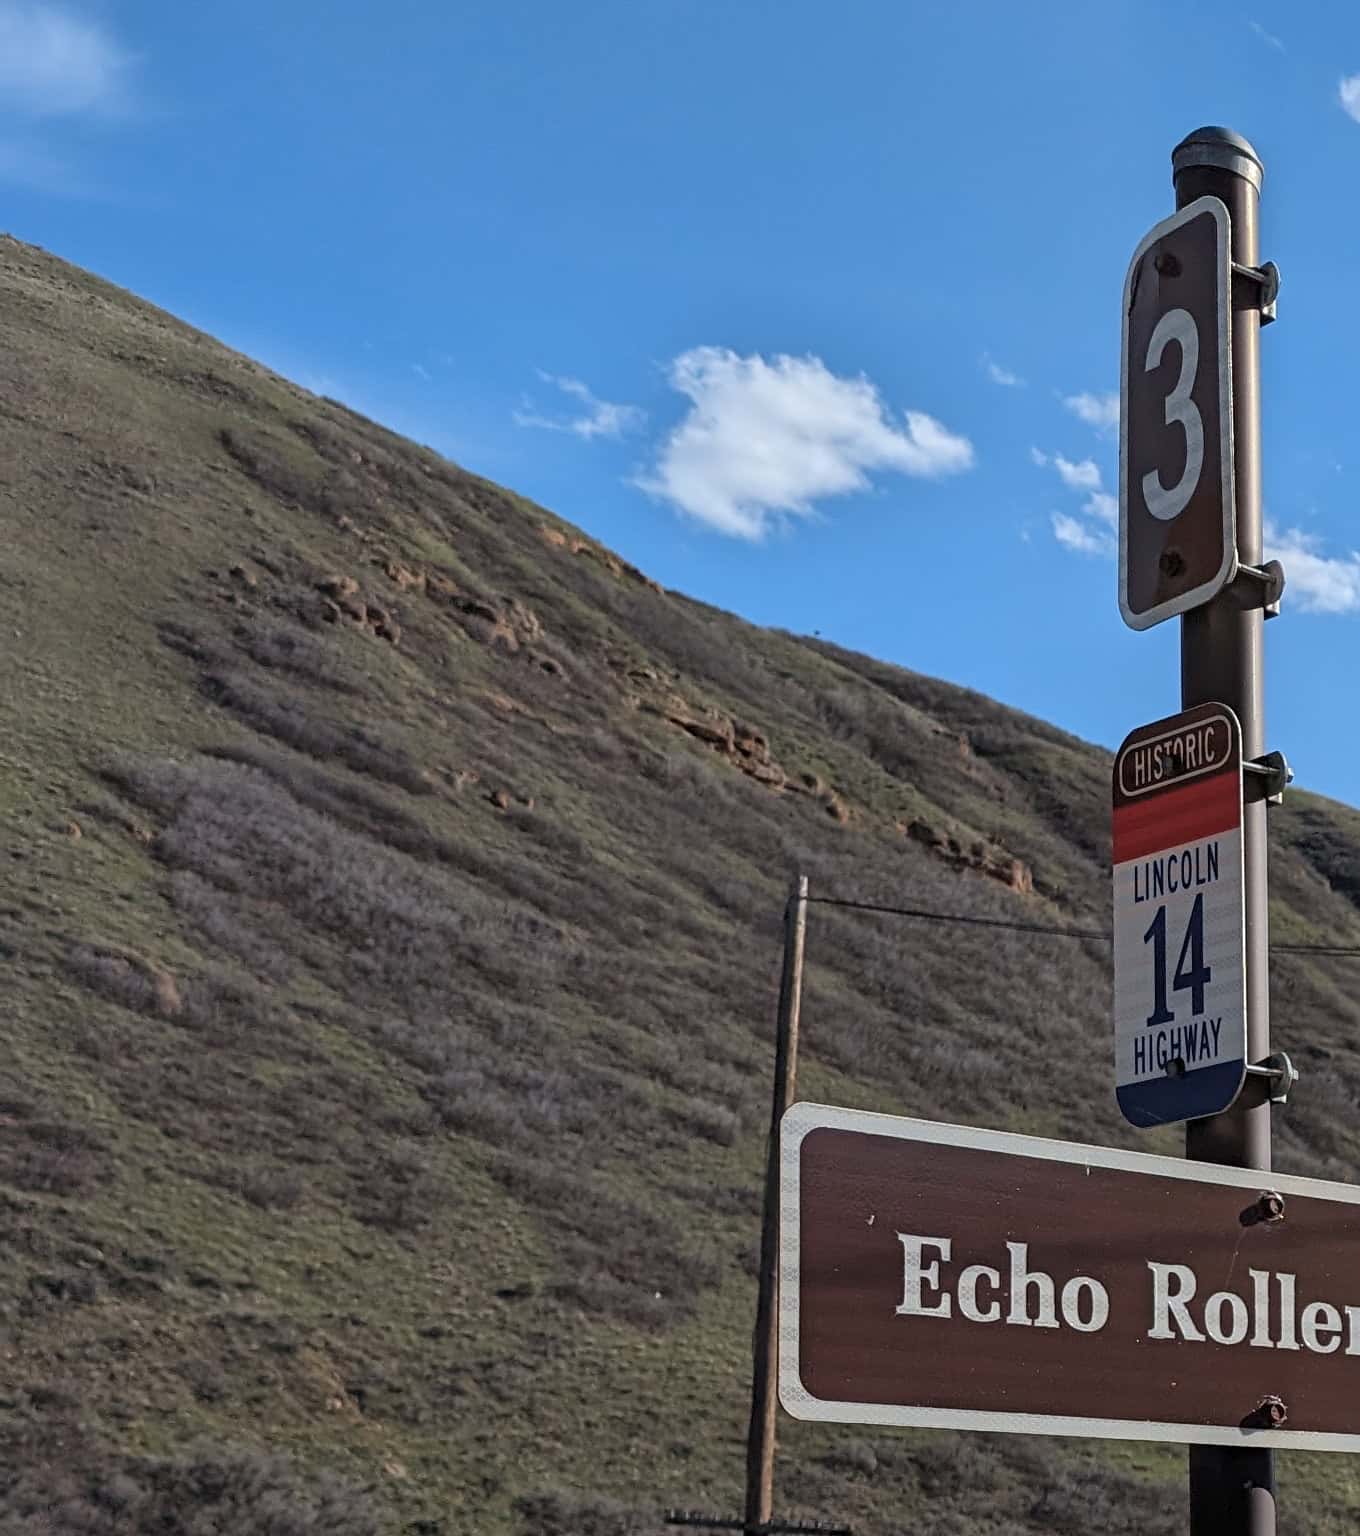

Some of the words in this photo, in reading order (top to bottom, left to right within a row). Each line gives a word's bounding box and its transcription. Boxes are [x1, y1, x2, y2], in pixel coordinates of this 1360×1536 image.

[1142, 308, 1204, 521] 3
[1135, 842, 1219, 903] LINCOLN
[1144, 892, 1211, 1027] 14
[1134, 1017, 1222, 1076] HIGHWAY
[895, 1231, 1110, 1333] Echo
